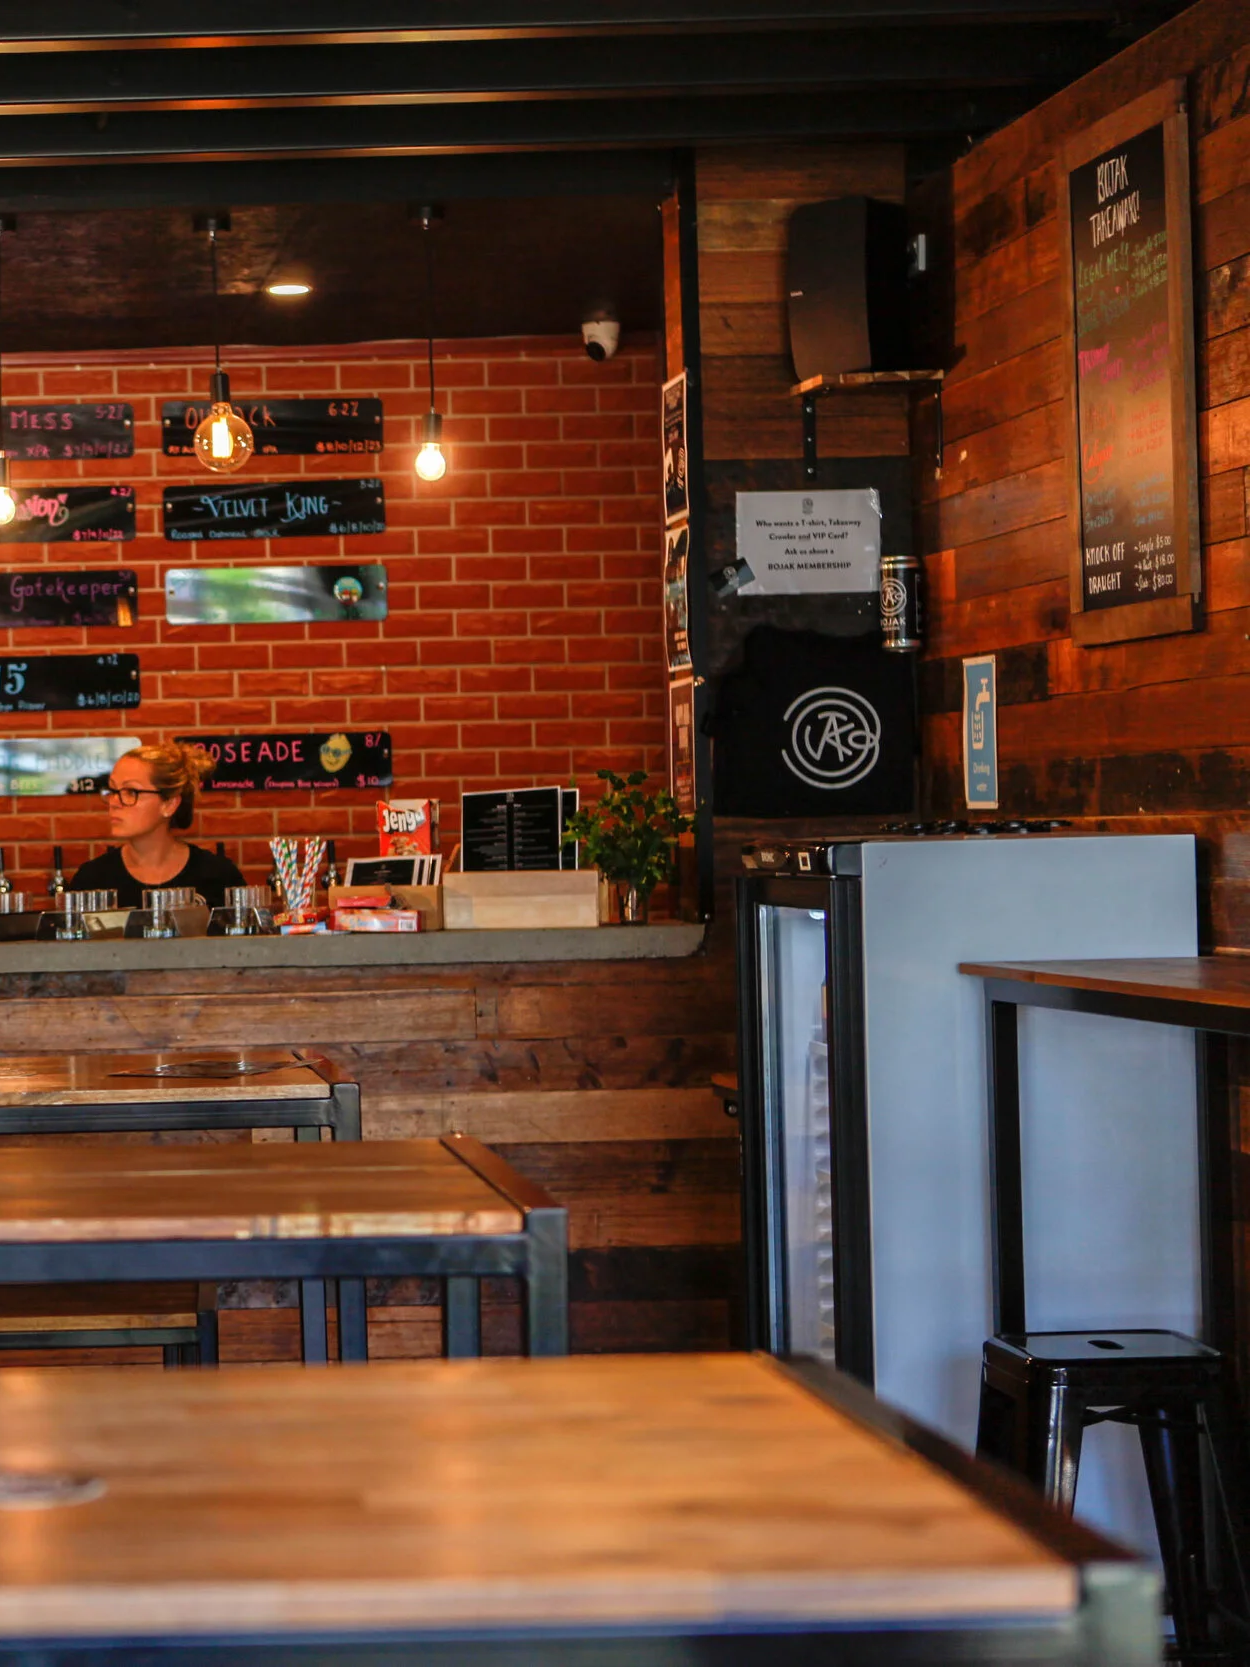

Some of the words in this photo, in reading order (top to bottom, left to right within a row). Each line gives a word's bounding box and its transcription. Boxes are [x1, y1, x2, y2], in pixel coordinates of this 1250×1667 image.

[10, 409, 74, 430] MESS
[200, 495, 269, 518] VELVET
[280, 492, 329, 523] KING
[809, 547, 828, 555] about
[1085, 544, 1110, 566] KNOCK
[1112, 541, 1125, 561] OFF
[797, 561, 852, 571] MEMBERSHIP
[10, 575, 124, 613] Gatekeeper
[1088, 571, 1121, 594] DRAUGHT
[193, 740, 305, 763] OSEADE
